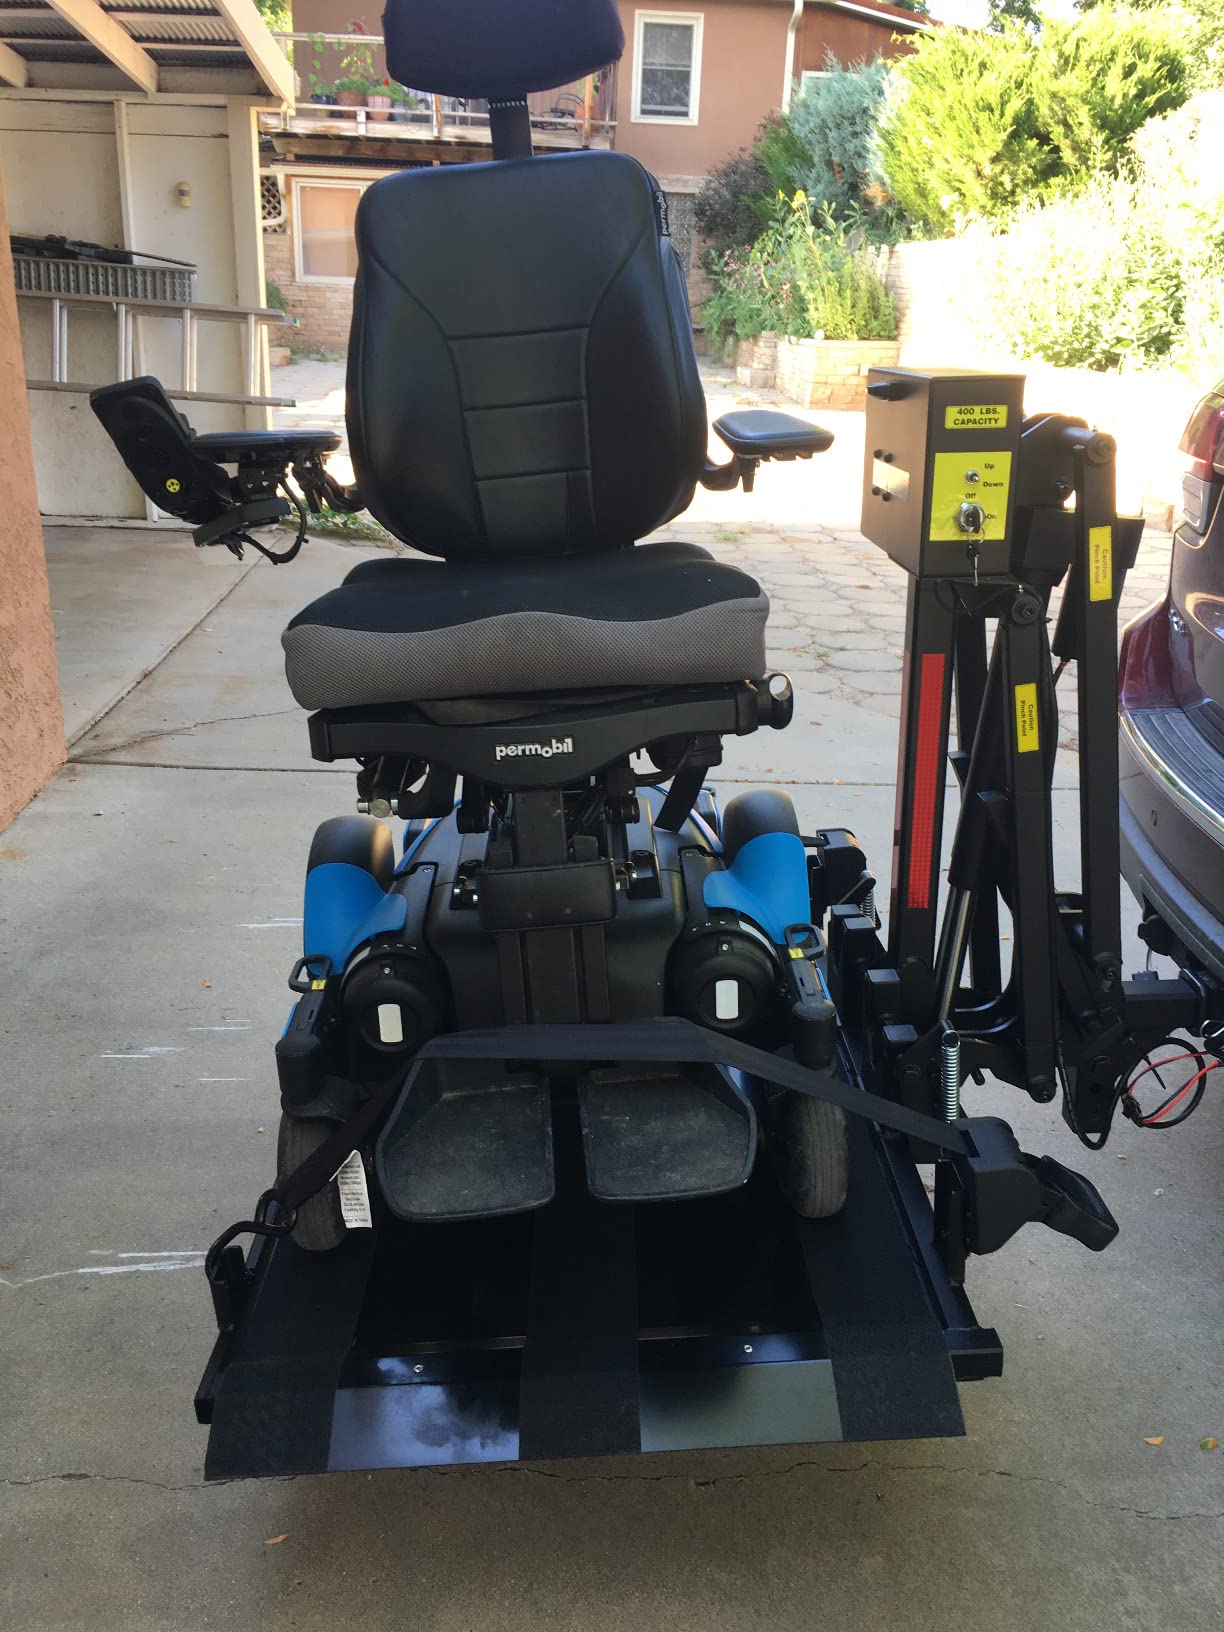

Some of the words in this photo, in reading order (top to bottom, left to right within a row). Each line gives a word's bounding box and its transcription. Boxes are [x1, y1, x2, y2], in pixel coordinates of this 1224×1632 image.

[655, 191, 668, 235] permobil
[957, 407, 975, 415] 400
[979, 407, 1000, 415] LBS.
[953, 417, 1000, 426] CAPACITY
[495, 738, 573, 761] permobil
